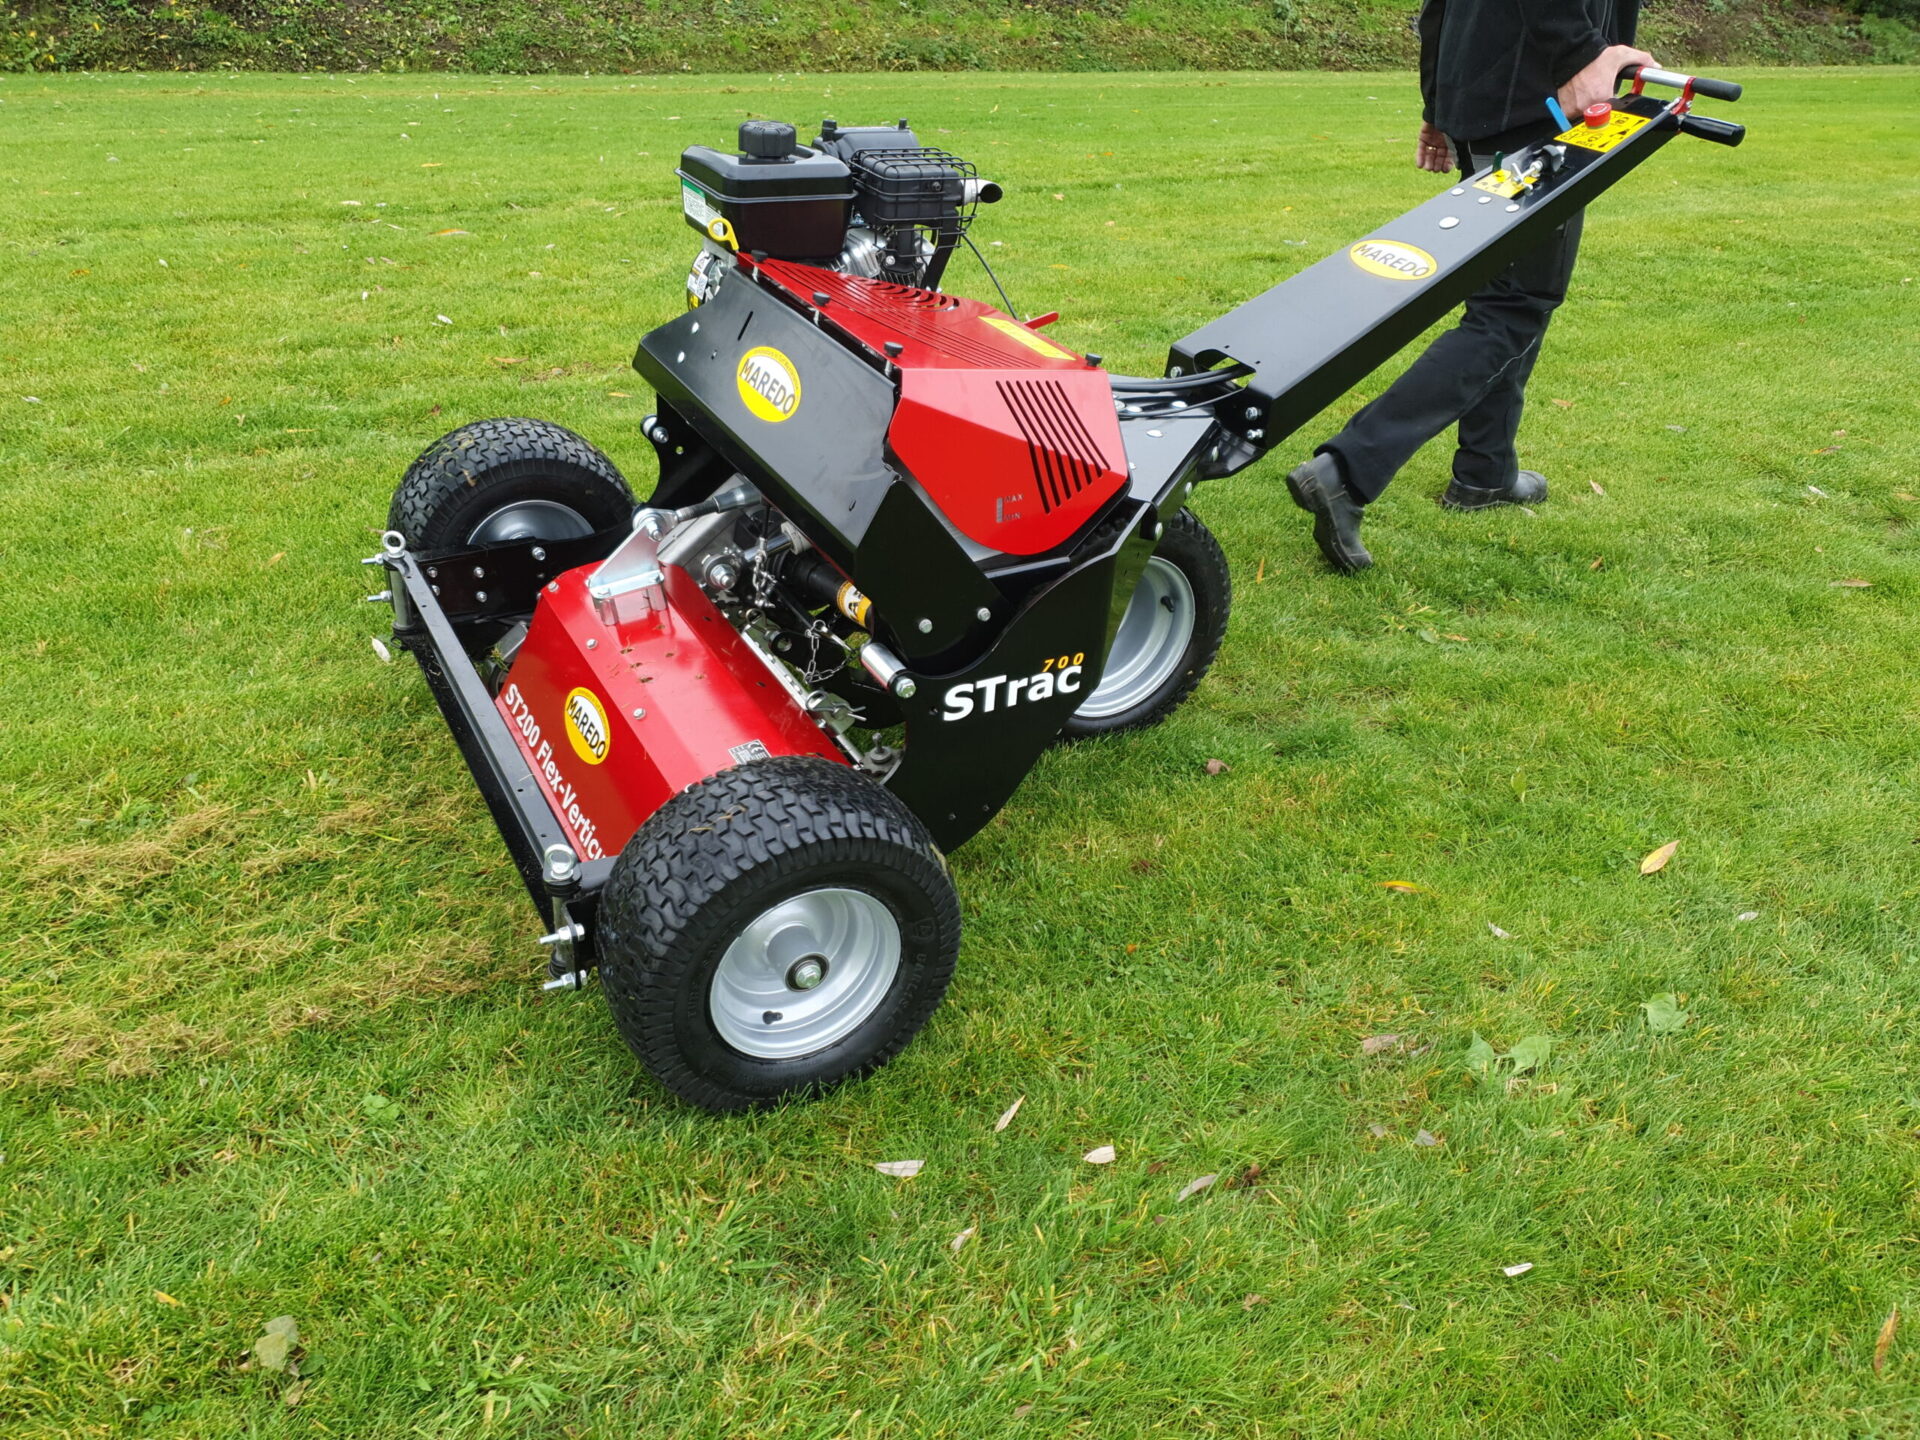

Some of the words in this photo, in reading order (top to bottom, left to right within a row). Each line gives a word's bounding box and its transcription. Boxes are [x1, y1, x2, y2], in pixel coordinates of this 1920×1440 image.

[1353, 244, 1430, 277] MAREDO
[739, 358, 796, 415] MAREDO
[1042, 652, 1085, 673] 700
[505, 684, 540, 748] ST200
[943, 665, 1082, 722] STrac
[566, 696, 606, 759] MAREDO
